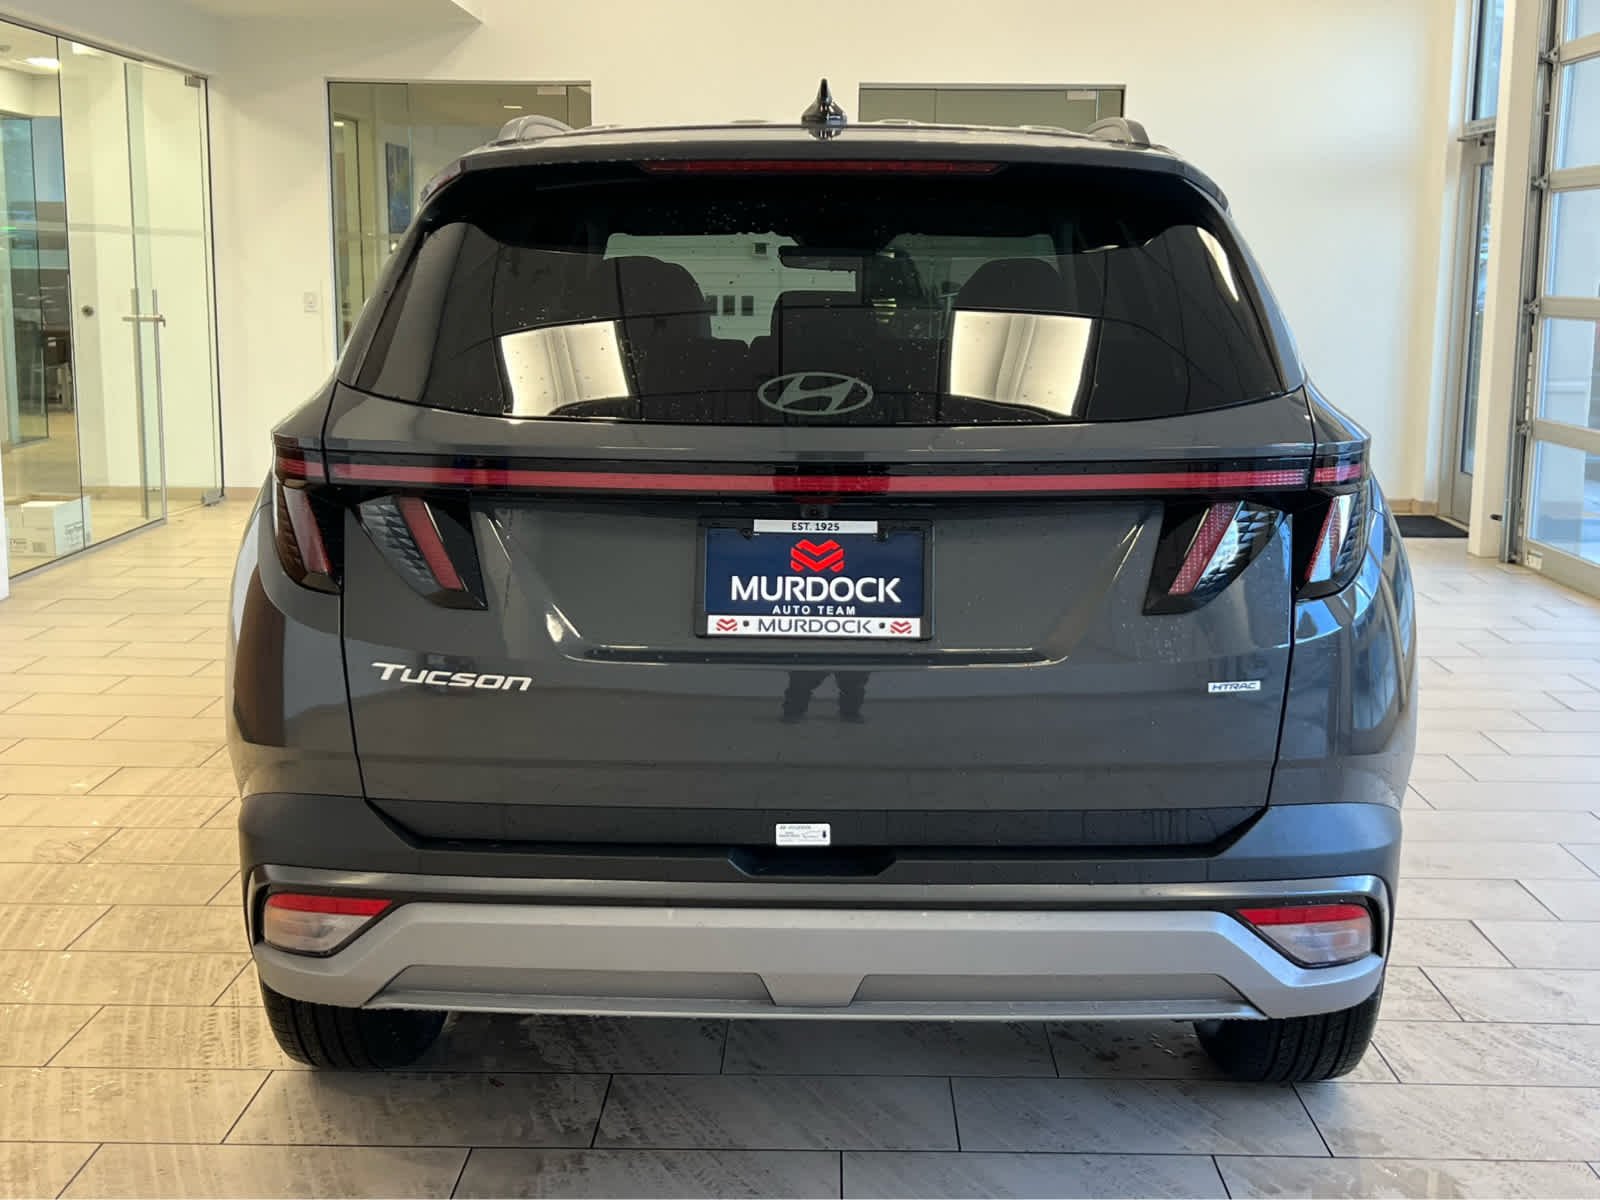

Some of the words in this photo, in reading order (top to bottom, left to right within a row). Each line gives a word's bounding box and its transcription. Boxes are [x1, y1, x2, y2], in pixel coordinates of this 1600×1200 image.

[791, 522, 813, 531] EST.
[815, 522, 840, 531] 1925
[730, 576, 902, 603] MURDOCK
[772, 605, 810, 615] AUTO
[817, 605, 856, 616] TEAM
[757, 618, 873, 634] MURDOCK
[1211, 682, 1257, 691] HTRAC
